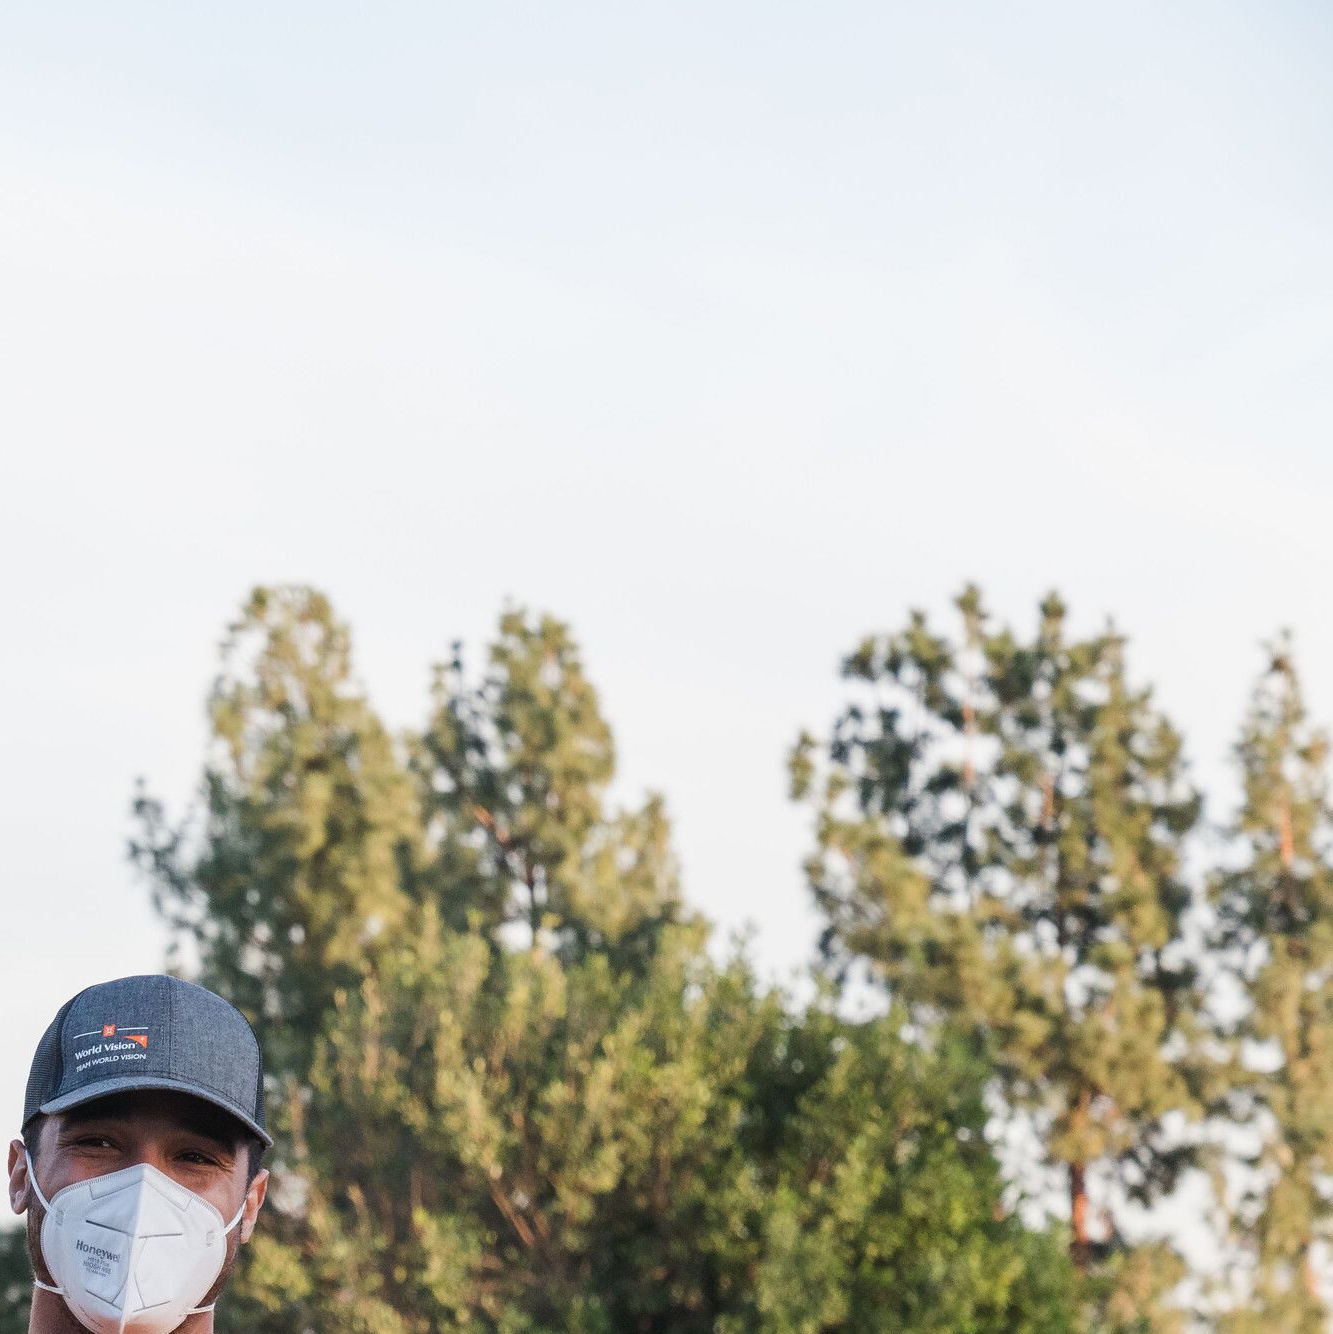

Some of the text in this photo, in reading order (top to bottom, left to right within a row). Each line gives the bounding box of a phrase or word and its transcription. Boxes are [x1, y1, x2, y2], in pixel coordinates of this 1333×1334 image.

[74, 1042, 135, 1060] World Vision
[76, 1053, 147, 1073] TEAM WORLD VISION
